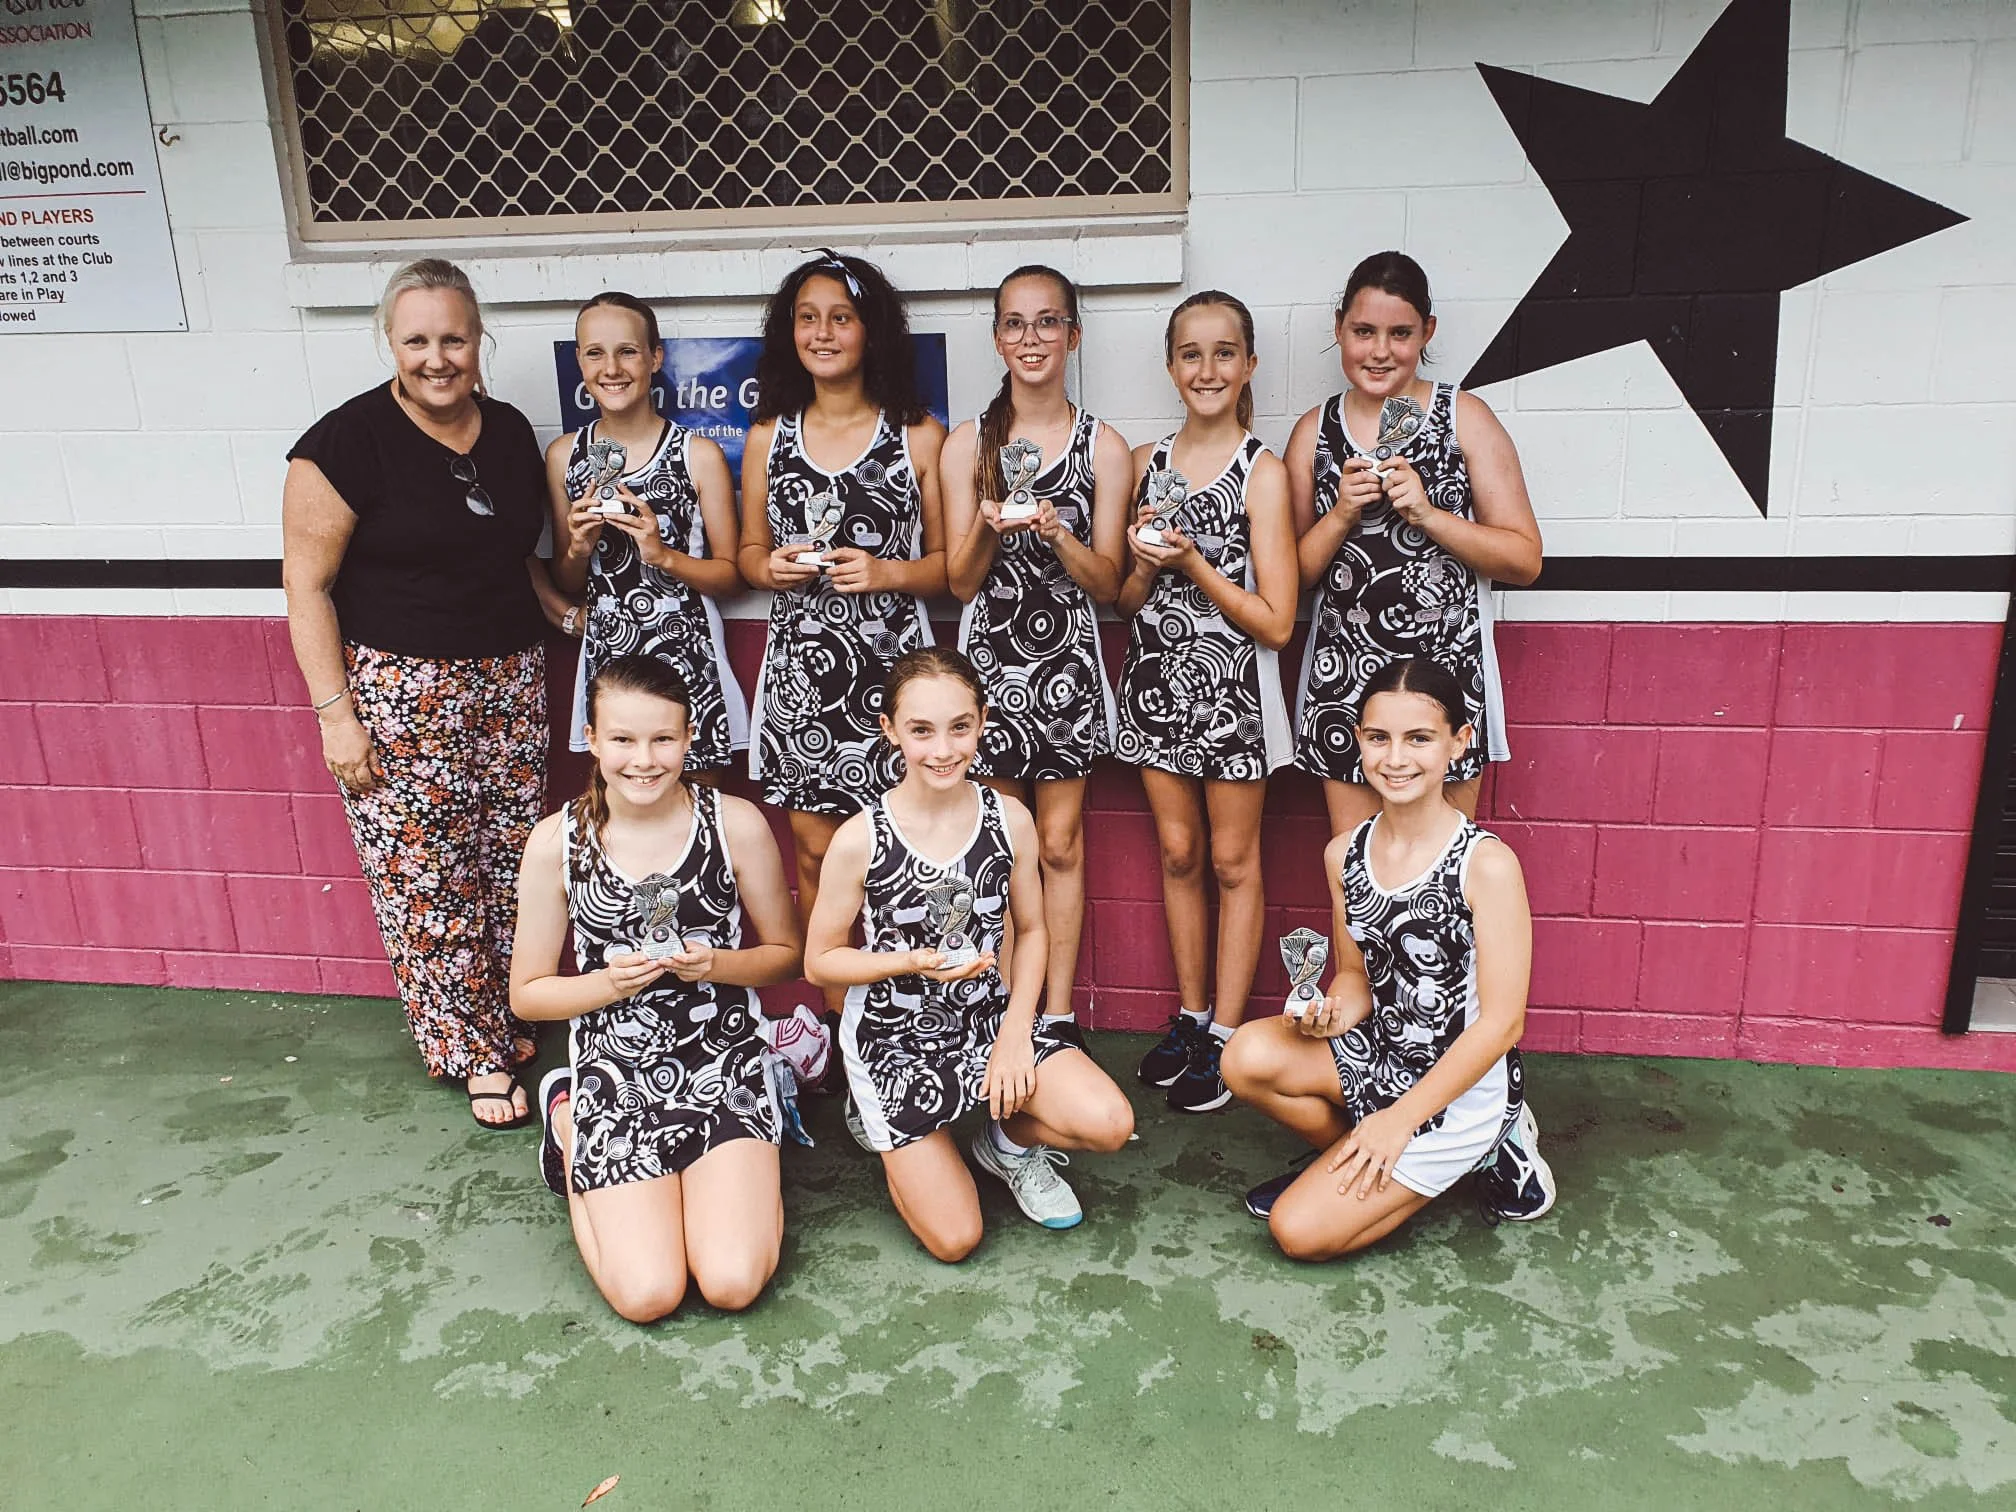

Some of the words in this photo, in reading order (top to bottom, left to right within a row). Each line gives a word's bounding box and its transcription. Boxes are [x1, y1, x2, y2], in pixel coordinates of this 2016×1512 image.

[22, 209, 94, 225] PLAYERS
[1, 236, 54, 248] between
[58, 234, 100, 246] courts
[8, 255, 39, 267] lines
[43, 254, 56, 266] at
[58, 253, 79, 266] the
[82, 252, 113, 265] Club
[21, 271, 39, 286] 1,2
[43, 271, 67, 283] and
[70, 270, 78, 282] 3
[0, 291, 18, 301] are
[21, 289, 34, 301] in
[37, 287, 65, 303] Play
[649, 386, 665, 409] n
[677, 377, 728, 409] the
[690, 426, 706, 437] art
[708, 424, 721, 437] of
[723, 424, 743, 437] the
